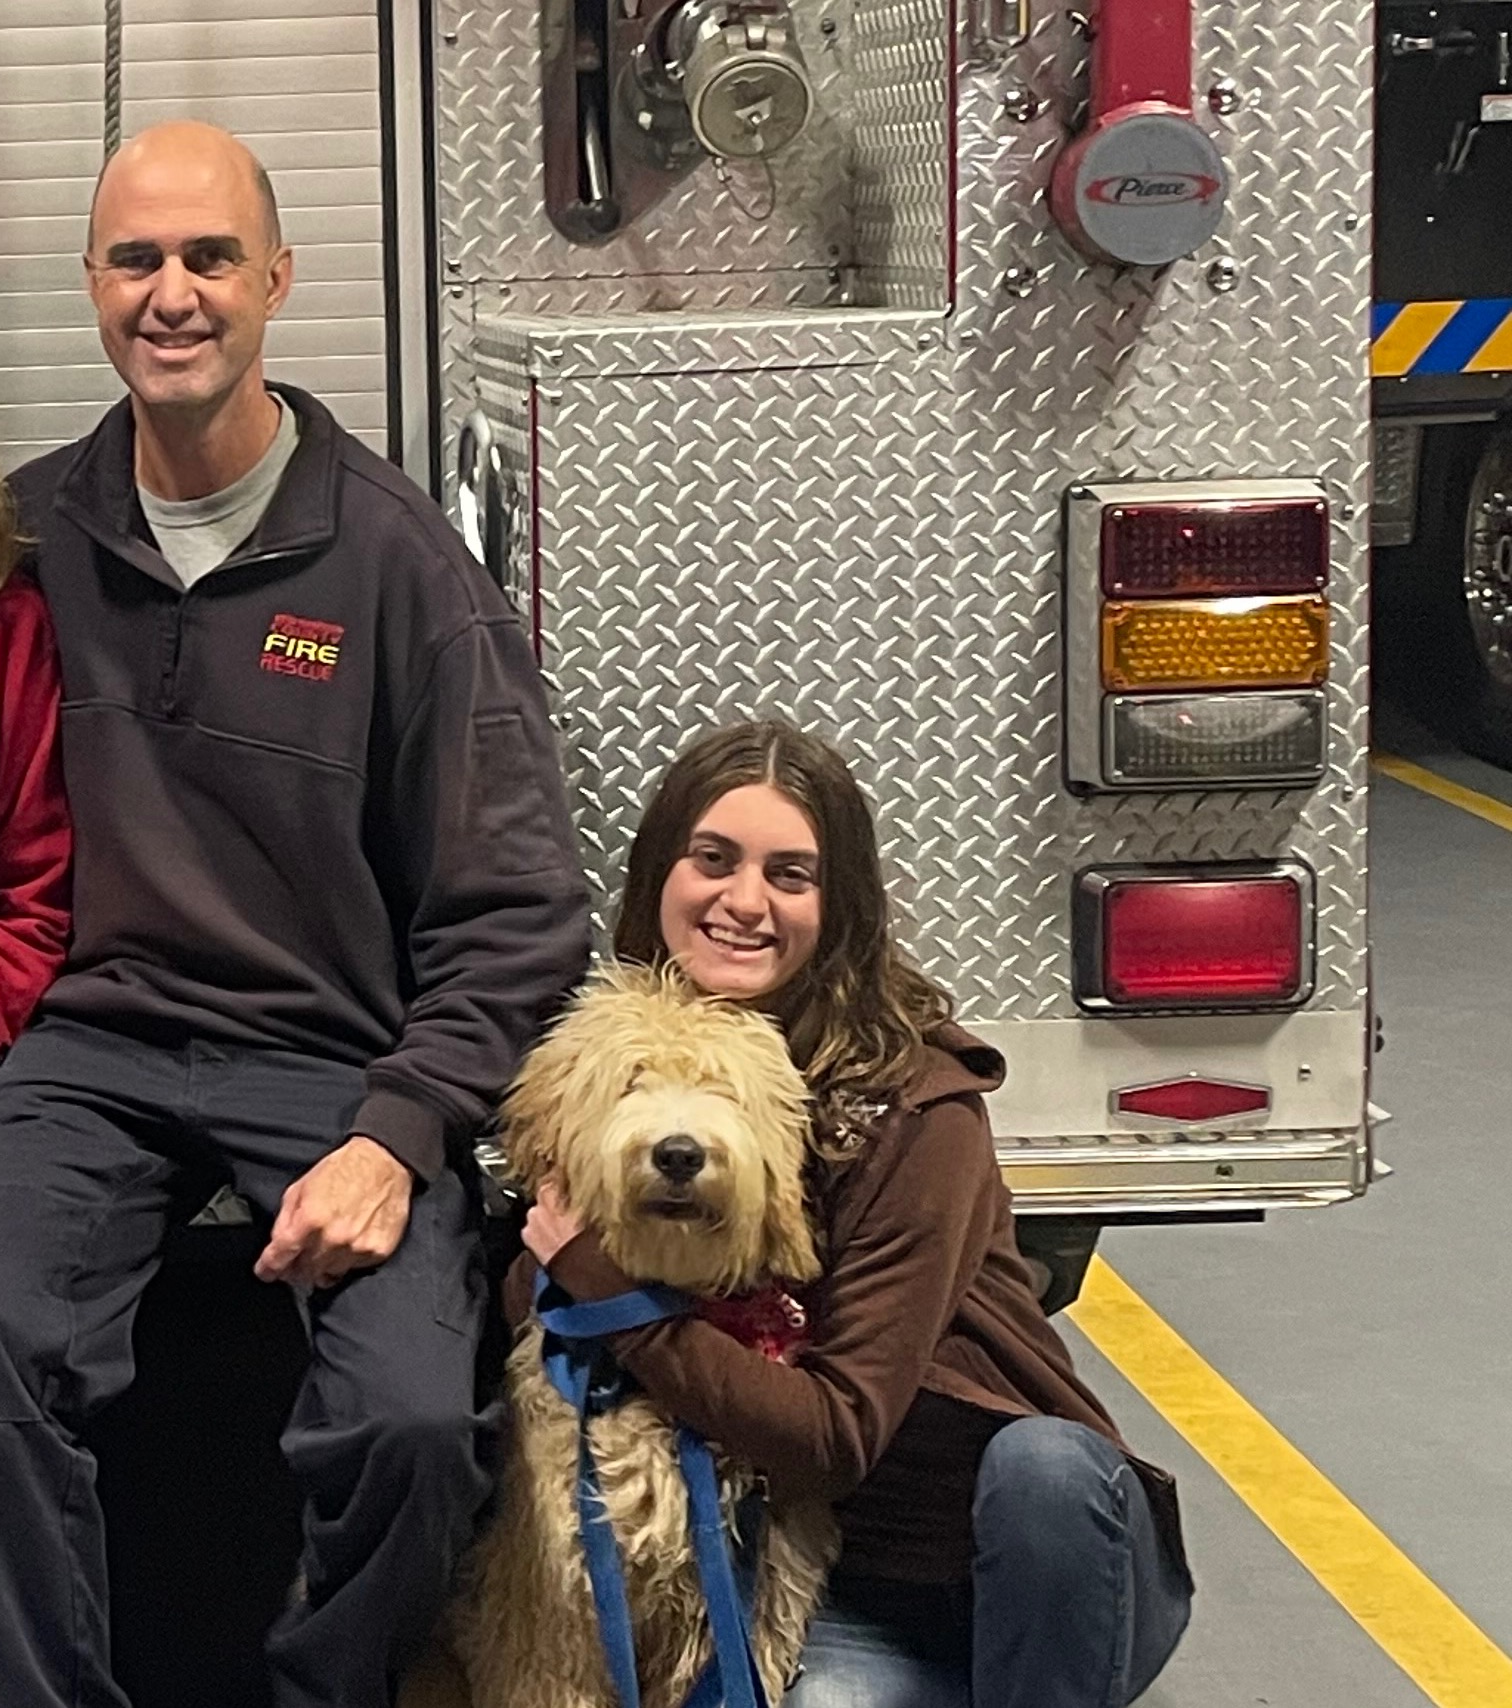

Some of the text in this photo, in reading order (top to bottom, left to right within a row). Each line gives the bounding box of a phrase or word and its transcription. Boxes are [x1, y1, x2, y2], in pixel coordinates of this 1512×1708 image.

[1114, 177, 1186, 203] Pierce
[263, 633, 340, 665] FIRE
[260, 652, 334, 681] RESCUE
